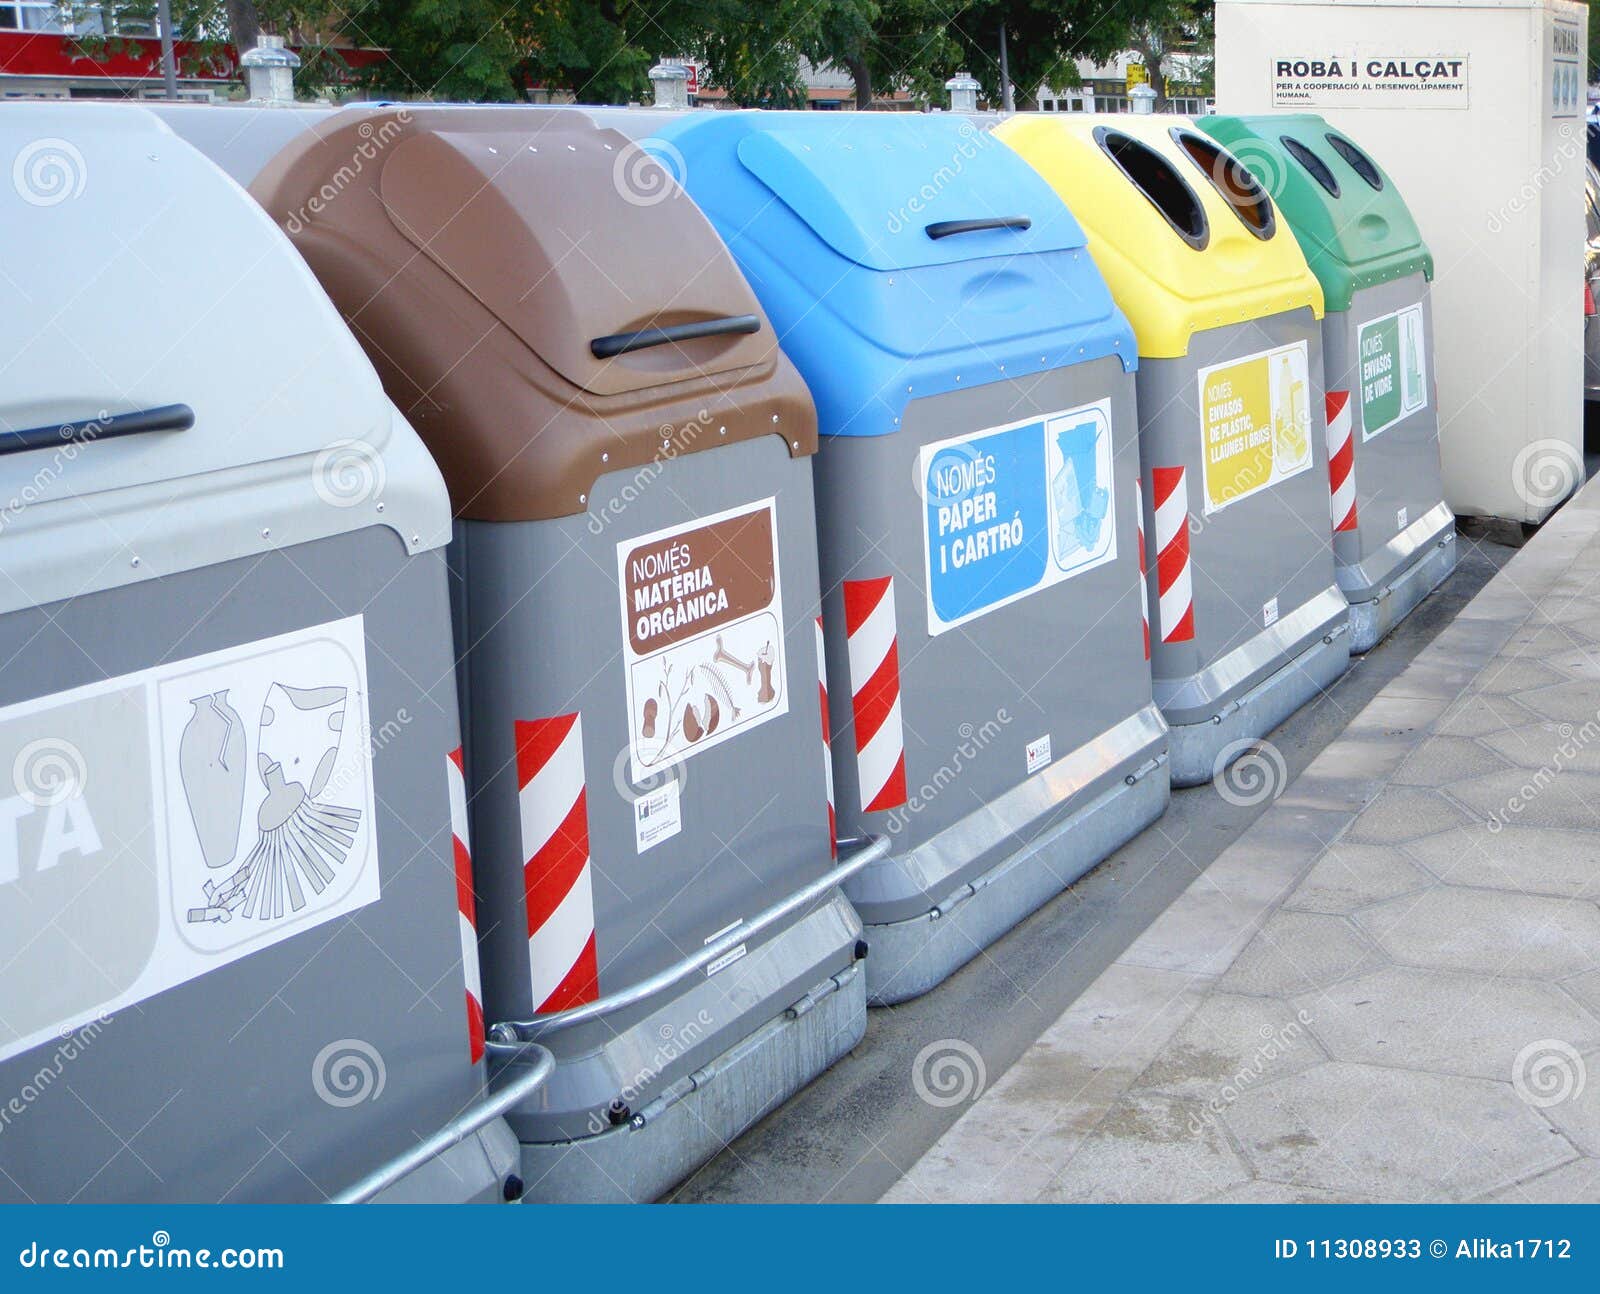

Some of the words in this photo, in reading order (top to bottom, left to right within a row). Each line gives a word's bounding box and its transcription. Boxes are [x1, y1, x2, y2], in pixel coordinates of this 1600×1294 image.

[1303, 82, 1359, 90] COOPERACIÓ
[1375, 83, 1464, 91] DESENVOLUPAMENT
[1351, 61, 1358, 77] I
[1366, 61, 1462, 82] CALÇAT
[1362, 330, 1383, 356] NOMÉS
[1363, 352, 1392, 381] ENVASOS
[1364, 383, 1374, 404] DE
[1374, 374, 1393, 398] VIDRE
[1209, 396, 1243, 423] ENVASOS
[1210, 425, 1221, 444] DE
[1210, 437, 1244, 464] LLAUNES
[1244, 434, 1249, 450] I
[937, 450, 996, 500] NOMÉS
[938, 491, 997, 537] PAPER
[940, 544, 947, 574] I
[951, 510, 1023, 569] CARTRÓ
[632, 541, 691, 583] NOMÉS
[634, 565, 713, 612] MATÈRIA
[636, 587, 729, 640] ORGÀNICA
